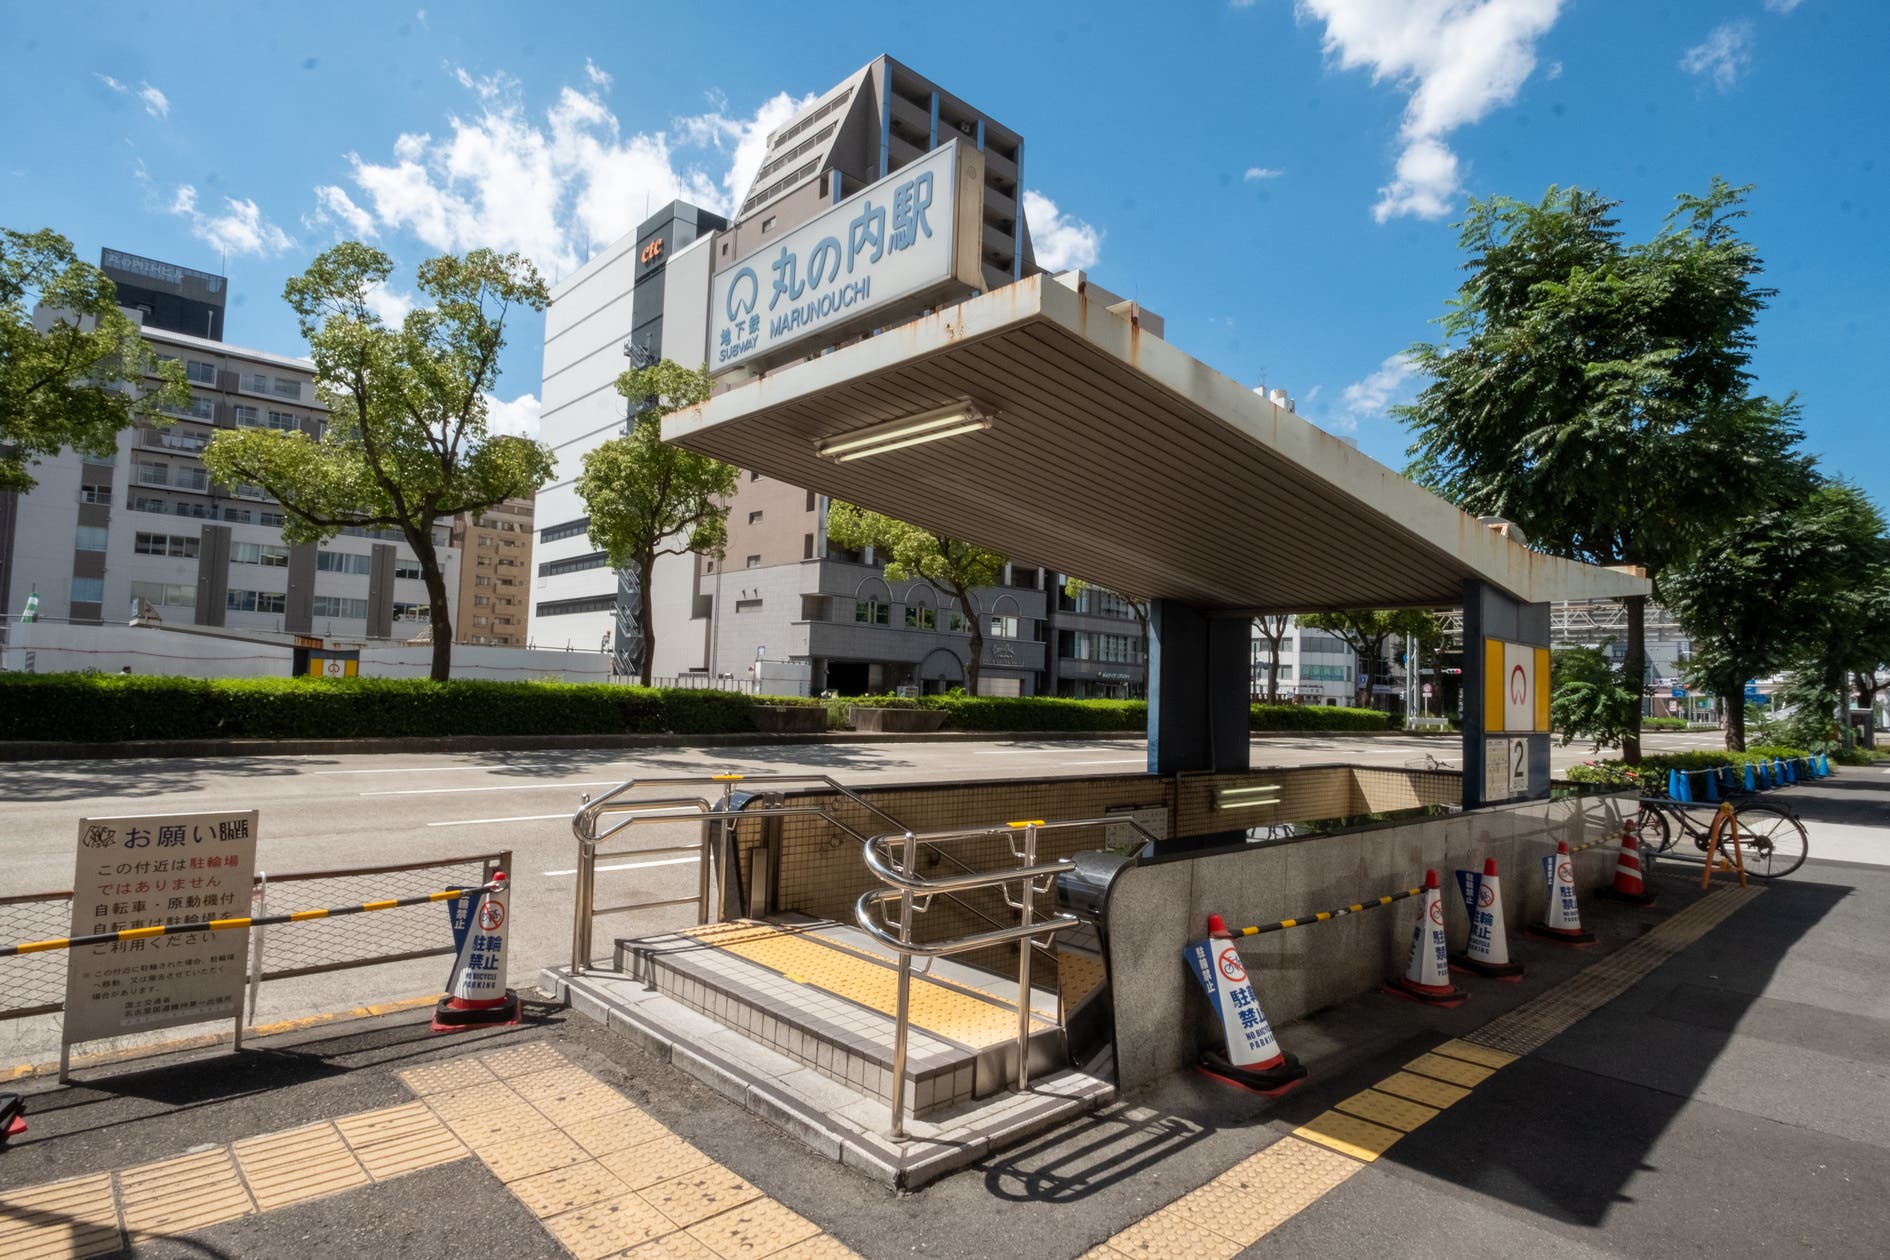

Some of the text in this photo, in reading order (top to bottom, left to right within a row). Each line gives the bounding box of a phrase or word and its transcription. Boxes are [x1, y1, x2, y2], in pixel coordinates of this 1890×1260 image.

[768, 170, 934, 311] 丸の内駅
[769, 275, 871, 340] MARUNOUCHI
[720, 312, 760, 347] 地下鉄
[719, 334, 760, 363] SUBWAY
[1514, 740, 1524, 777] 2
[124, 824, 216, 849] お願い
[97, 855, 239, 876] この付近は駐輪場
[98, 875, 222, 896] ではありません
[95, 893, 235, 917] 自転車・原動機付
[472, 935, 502, 952] 駐輪
[468, 953, 499, 970] 禁止
[1245, 1031, 1255, 1041] NO
